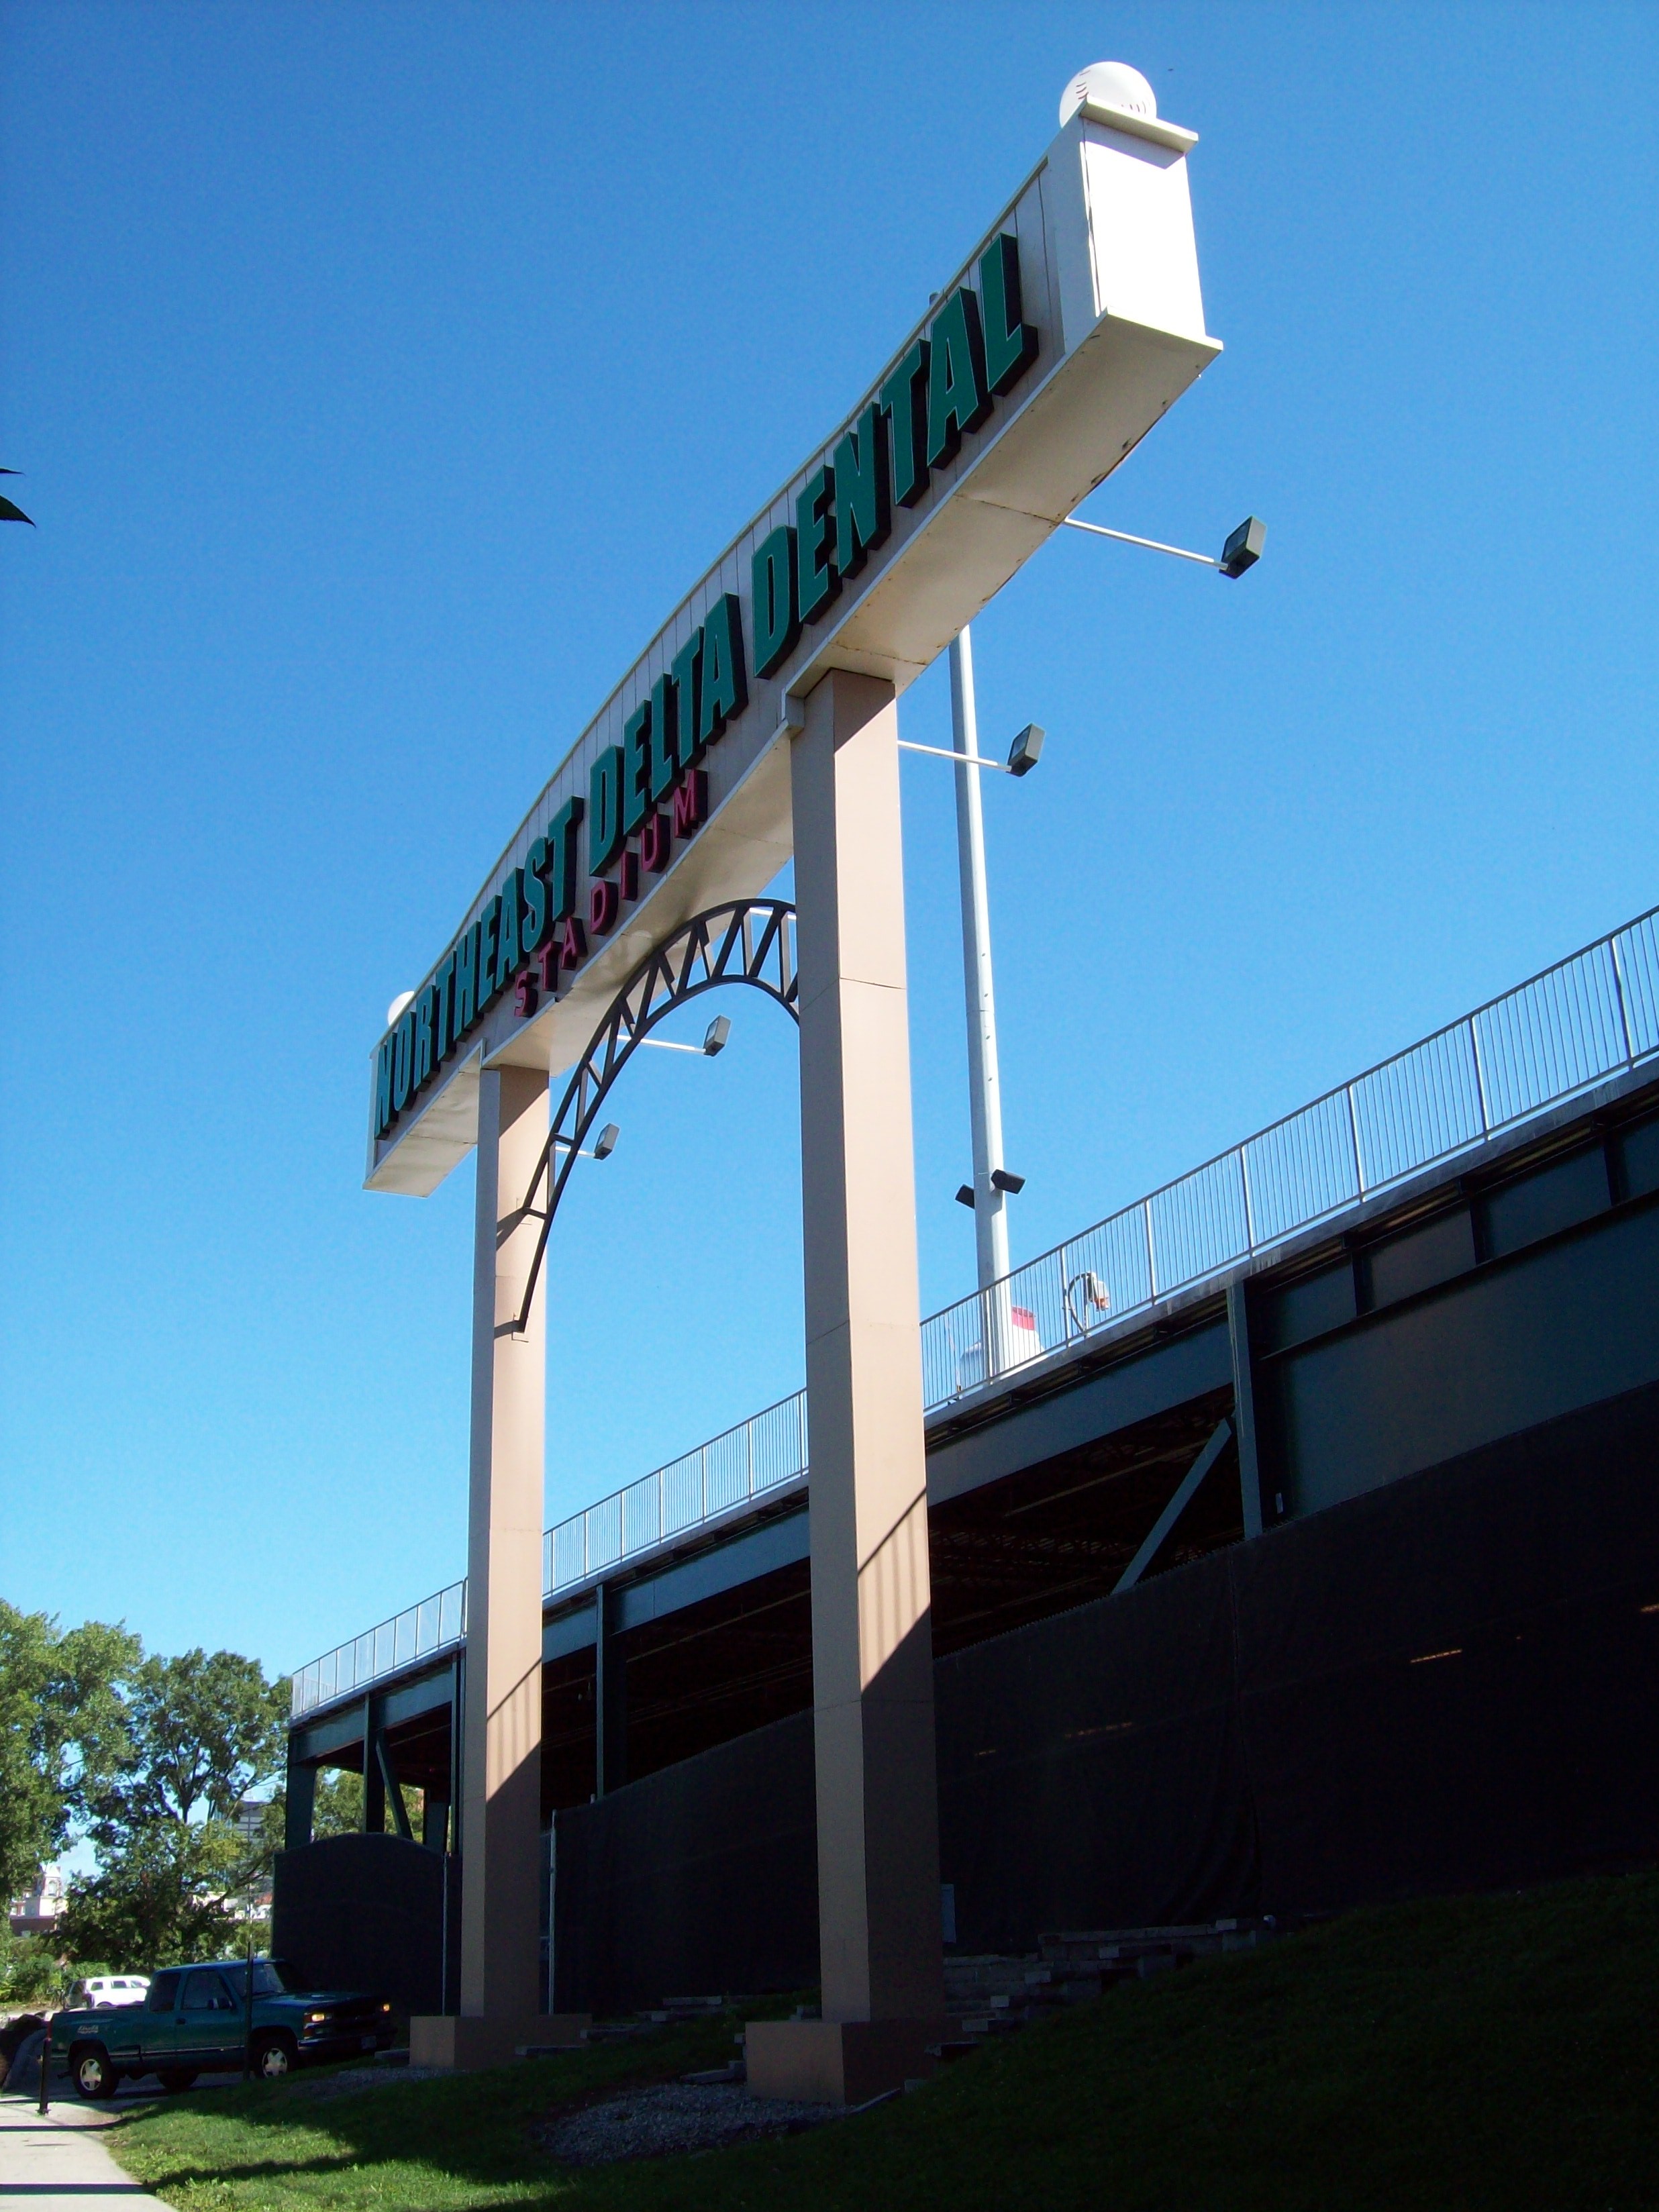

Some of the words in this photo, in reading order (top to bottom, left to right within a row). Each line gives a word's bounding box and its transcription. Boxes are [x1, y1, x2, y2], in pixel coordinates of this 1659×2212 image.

[374, 796, 583, 1140] NORTHEAST
[589, 592, 746, 876] DELTA
[752, 232, 1036, 678] DENTAL
[514, 769, 707, 1017] STADIUM
